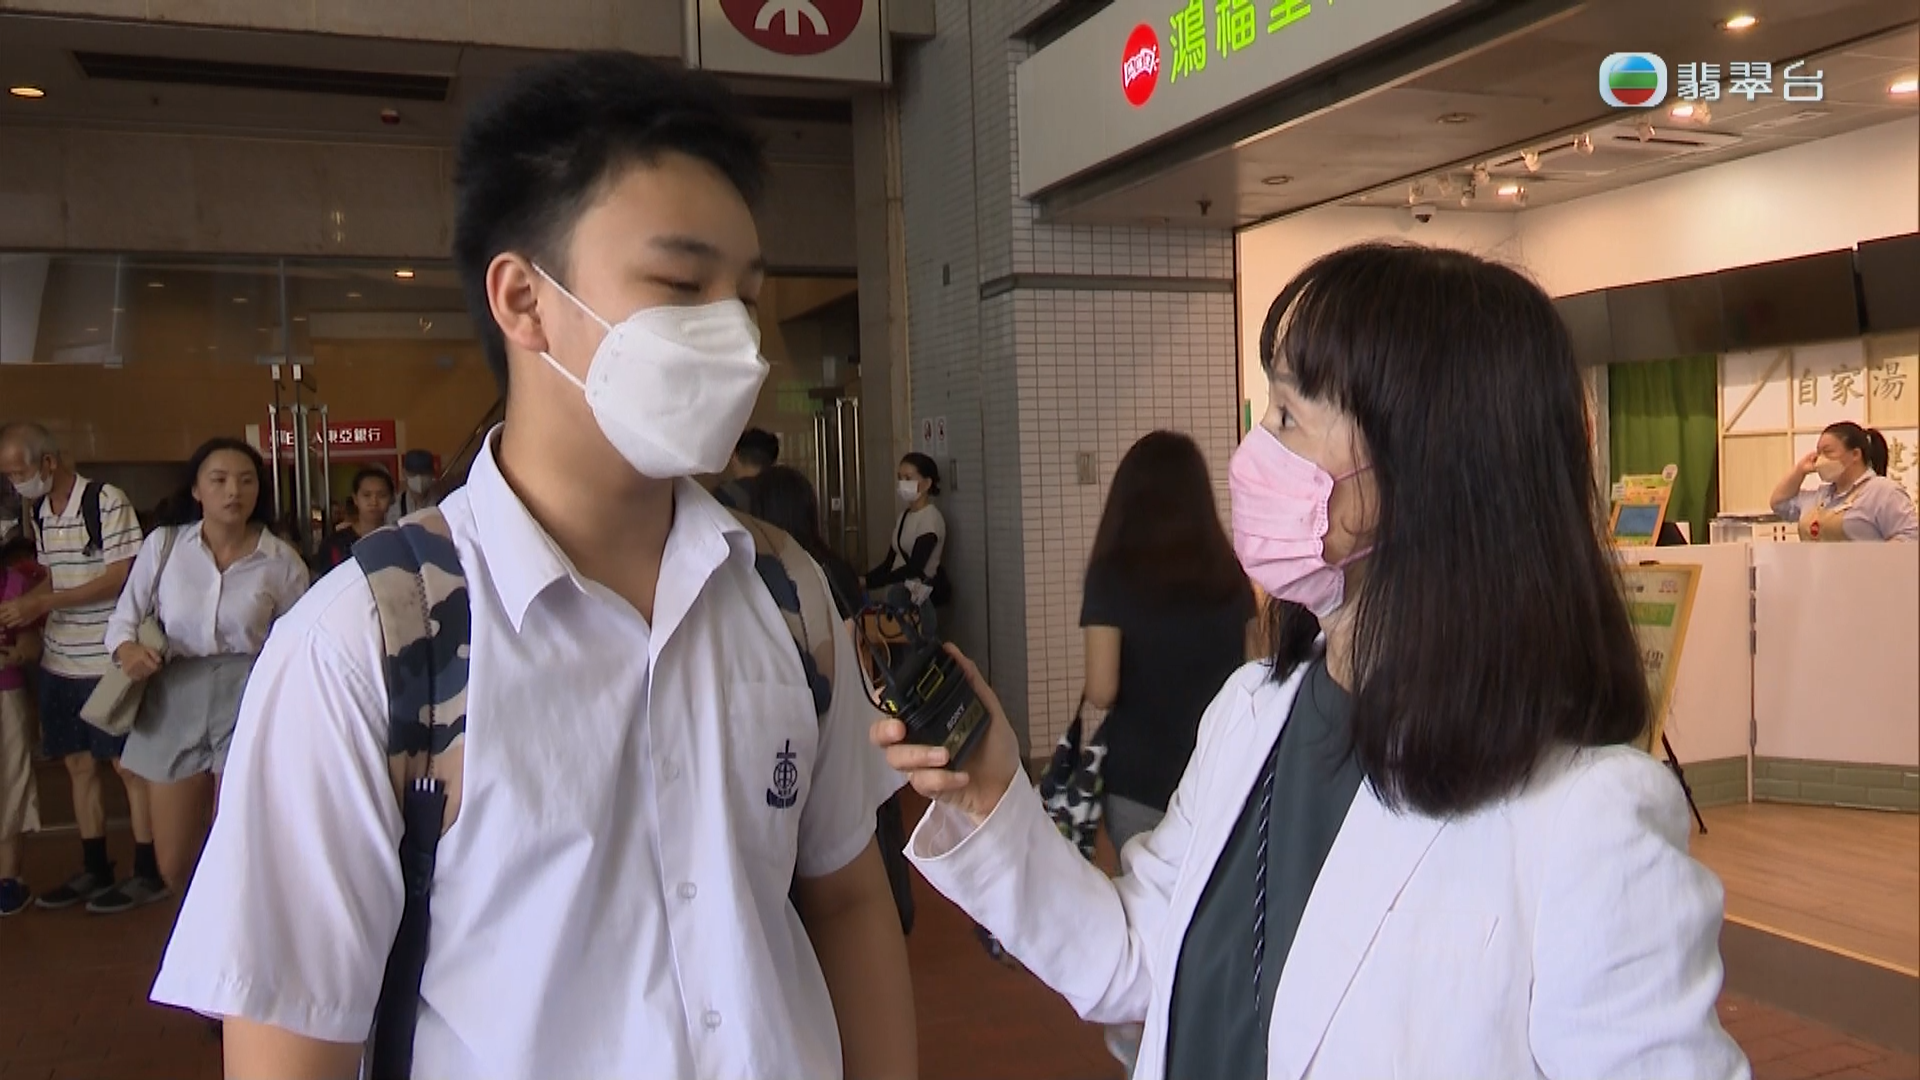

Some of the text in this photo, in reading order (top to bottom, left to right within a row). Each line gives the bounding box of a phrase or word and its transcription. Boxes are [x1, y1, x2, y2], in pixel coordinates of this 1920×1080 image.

[1798, 361, 1907, 407] 自家湯
[328, 427, 382, 443] 東亞銀行
